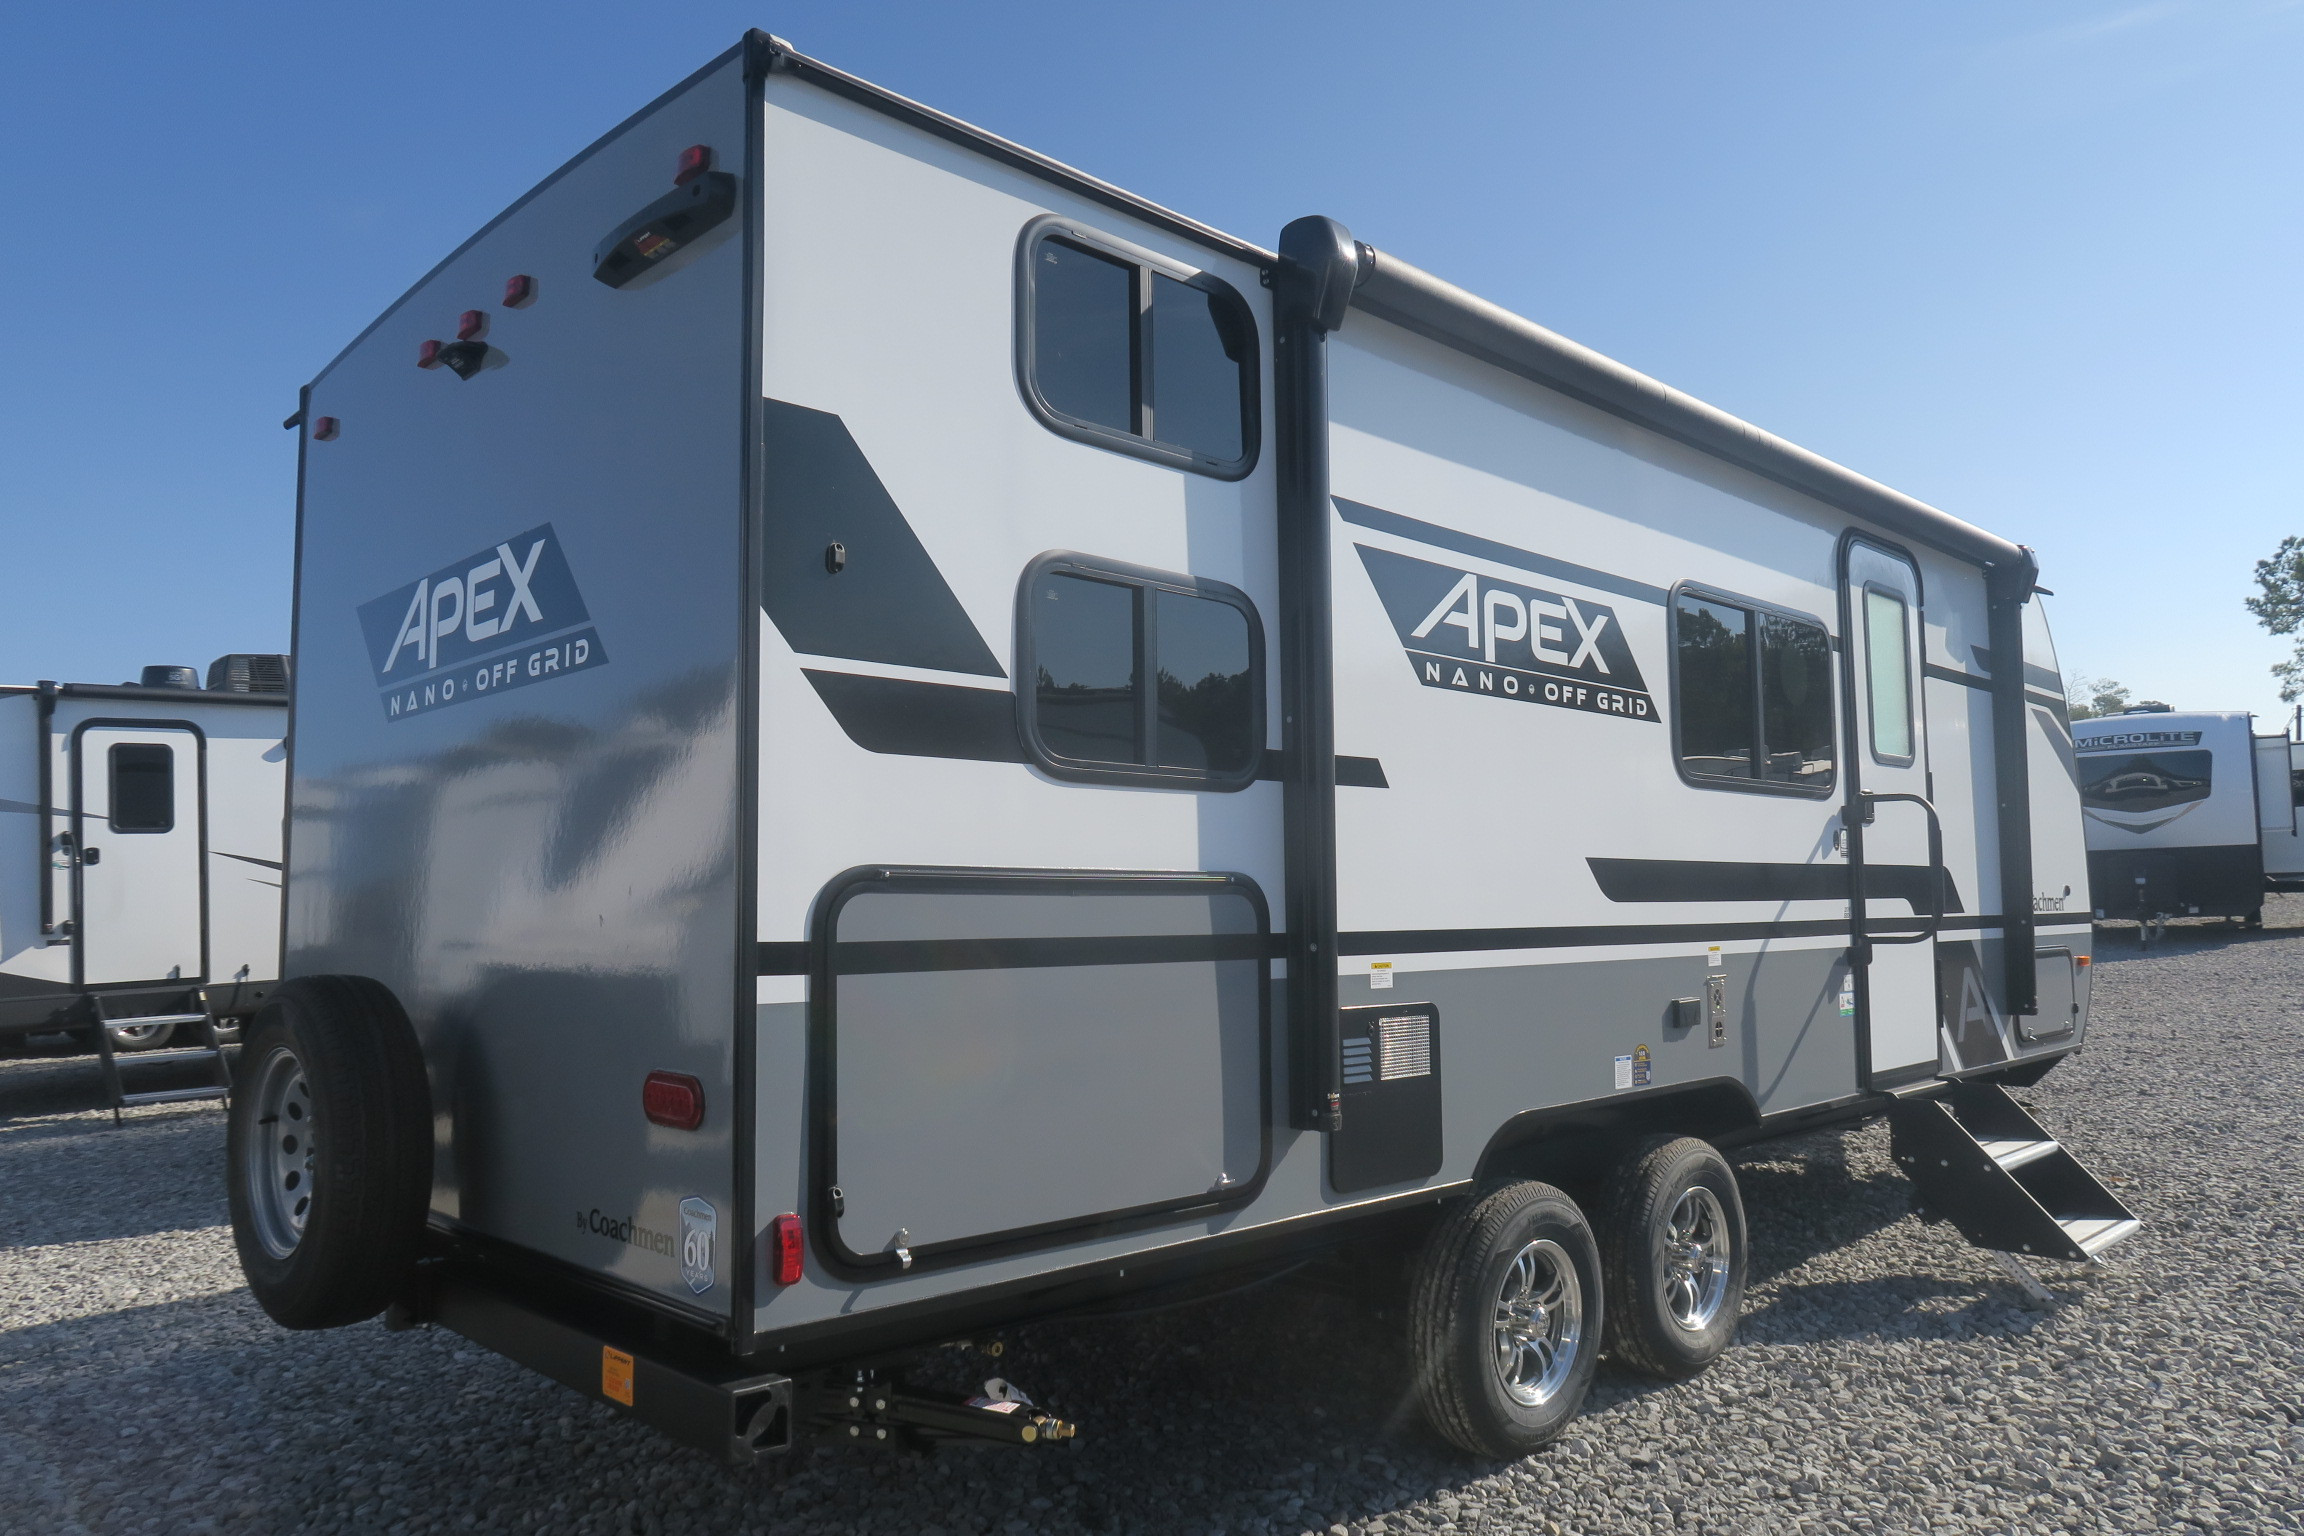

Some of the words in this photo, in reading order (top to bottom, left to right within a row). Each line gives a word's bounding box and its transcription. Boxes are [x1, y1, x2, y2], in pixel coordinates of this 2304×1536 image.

[382, 538, 546, 673] APEX
[1411, 572, 1611, 674] APEX
[390, 678, 454, 716] NANO
[476, 659, 517, 691] OFF
[528, 638, 589, 677] GRID
[1426, 661, 1519, 695] NANO
[1544, 682, 1587, 706] OFF
[1596, 692, 1647, 716] GRID
[2032, 891, 2065, 912] achmen
[576, 1211, 587, 1234] By
[589, 1208, 675, 1258] Coachmen
[683, 1206, 712, 1222] Coachmen
[684, 1228, 710, 1272] 60
[686, 1269, 709, 1283] YEARS
